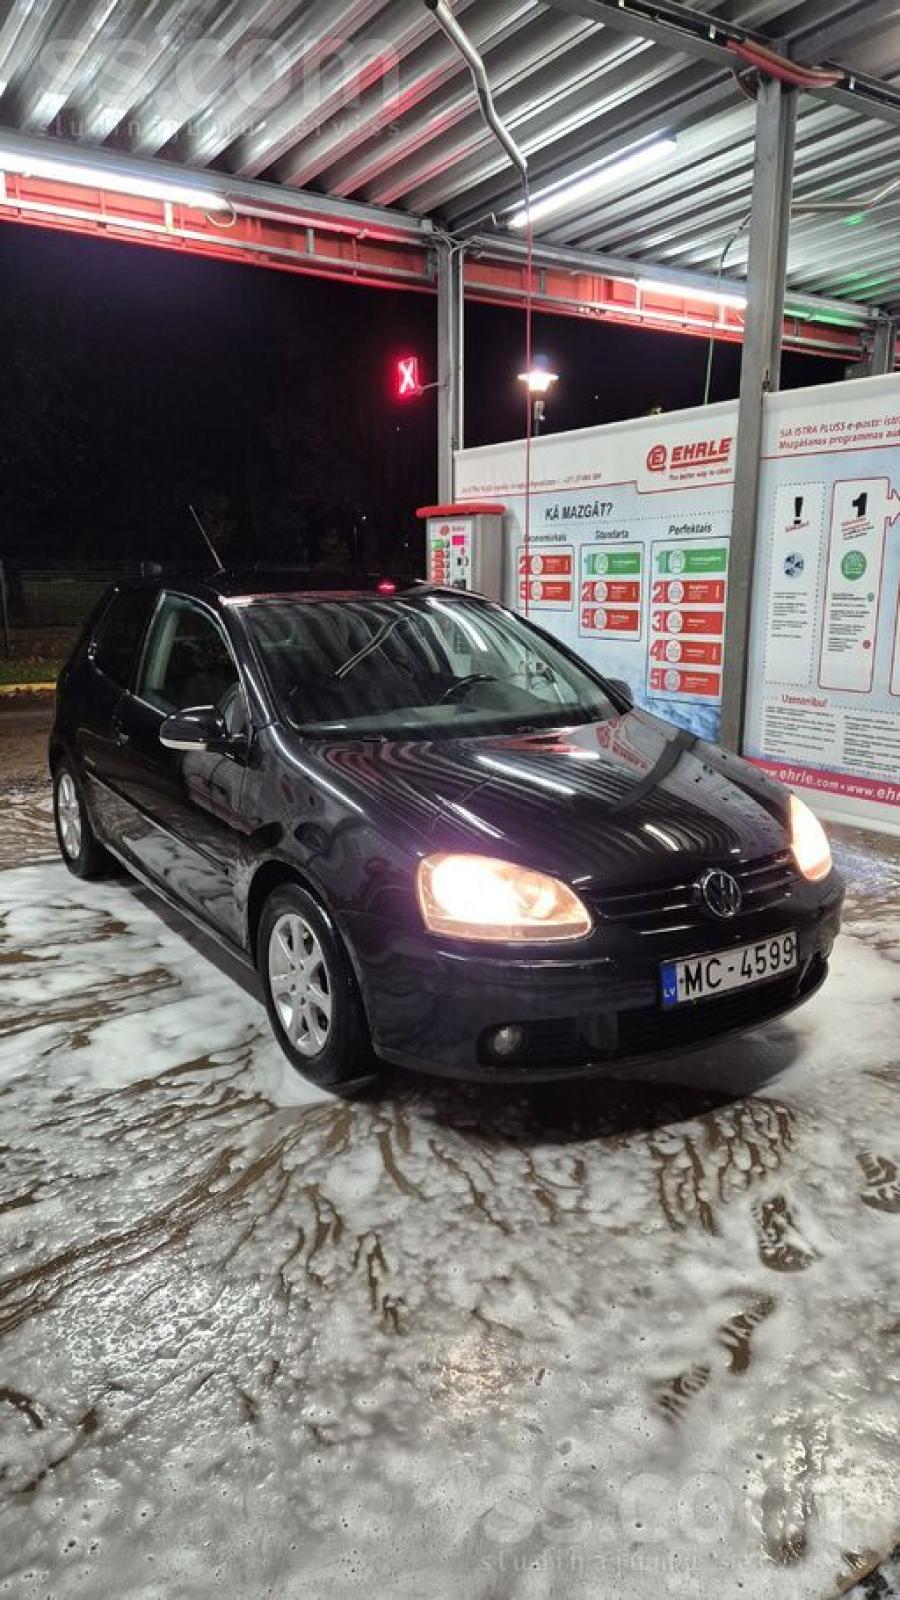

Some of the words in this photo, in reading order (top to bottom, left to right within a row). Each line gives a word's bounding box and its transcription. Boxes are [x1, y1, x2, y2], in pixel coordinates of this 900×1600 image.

[671, 437, 732, 462] EHRLE
[545, 504, 560, 521] KĀ
[562, 501, 614, 520] MAZGĀT?
[852, 492, 868, 517] 1
[668, 523, 713, 536] Perfektais
[652, 581, 666, 603] 2
[652, 611, 666, 633] 3
[683, 936, 795, 997] MC-4599
